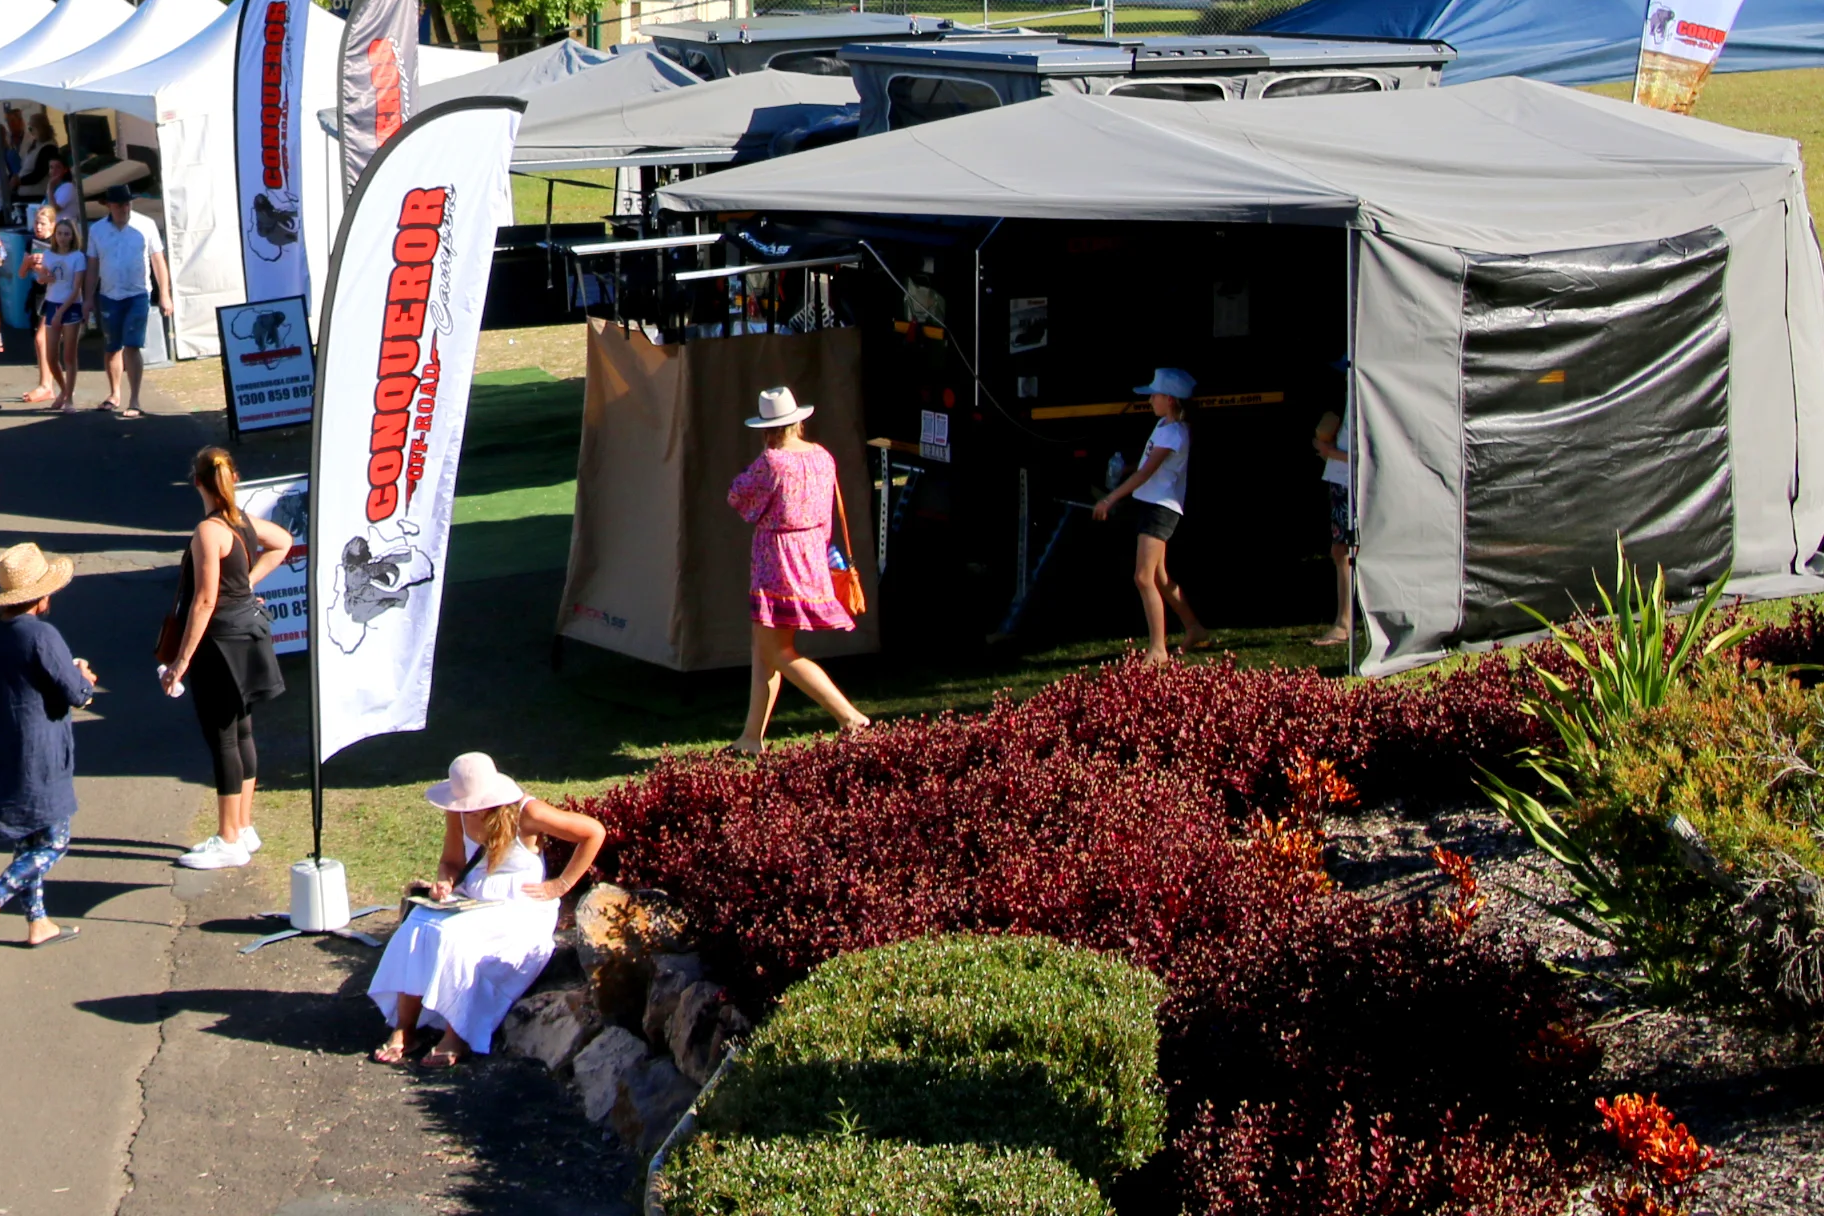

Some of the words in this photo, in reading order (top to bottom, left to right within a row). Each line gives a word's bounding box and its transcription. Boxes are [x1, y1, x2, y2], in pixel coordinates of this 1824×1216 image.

[261, 1, 288, 189] CONQUEROR
[430, 183, 457, 335] Campers
[237, 391, 265, 406] 1300
[268, 388, 290, 402] 859
[366, 186, 447, 524] CONQUEROR
[407, 362, 440, 481] OFF-ROAD
[293, 600, 307, 616] 85
